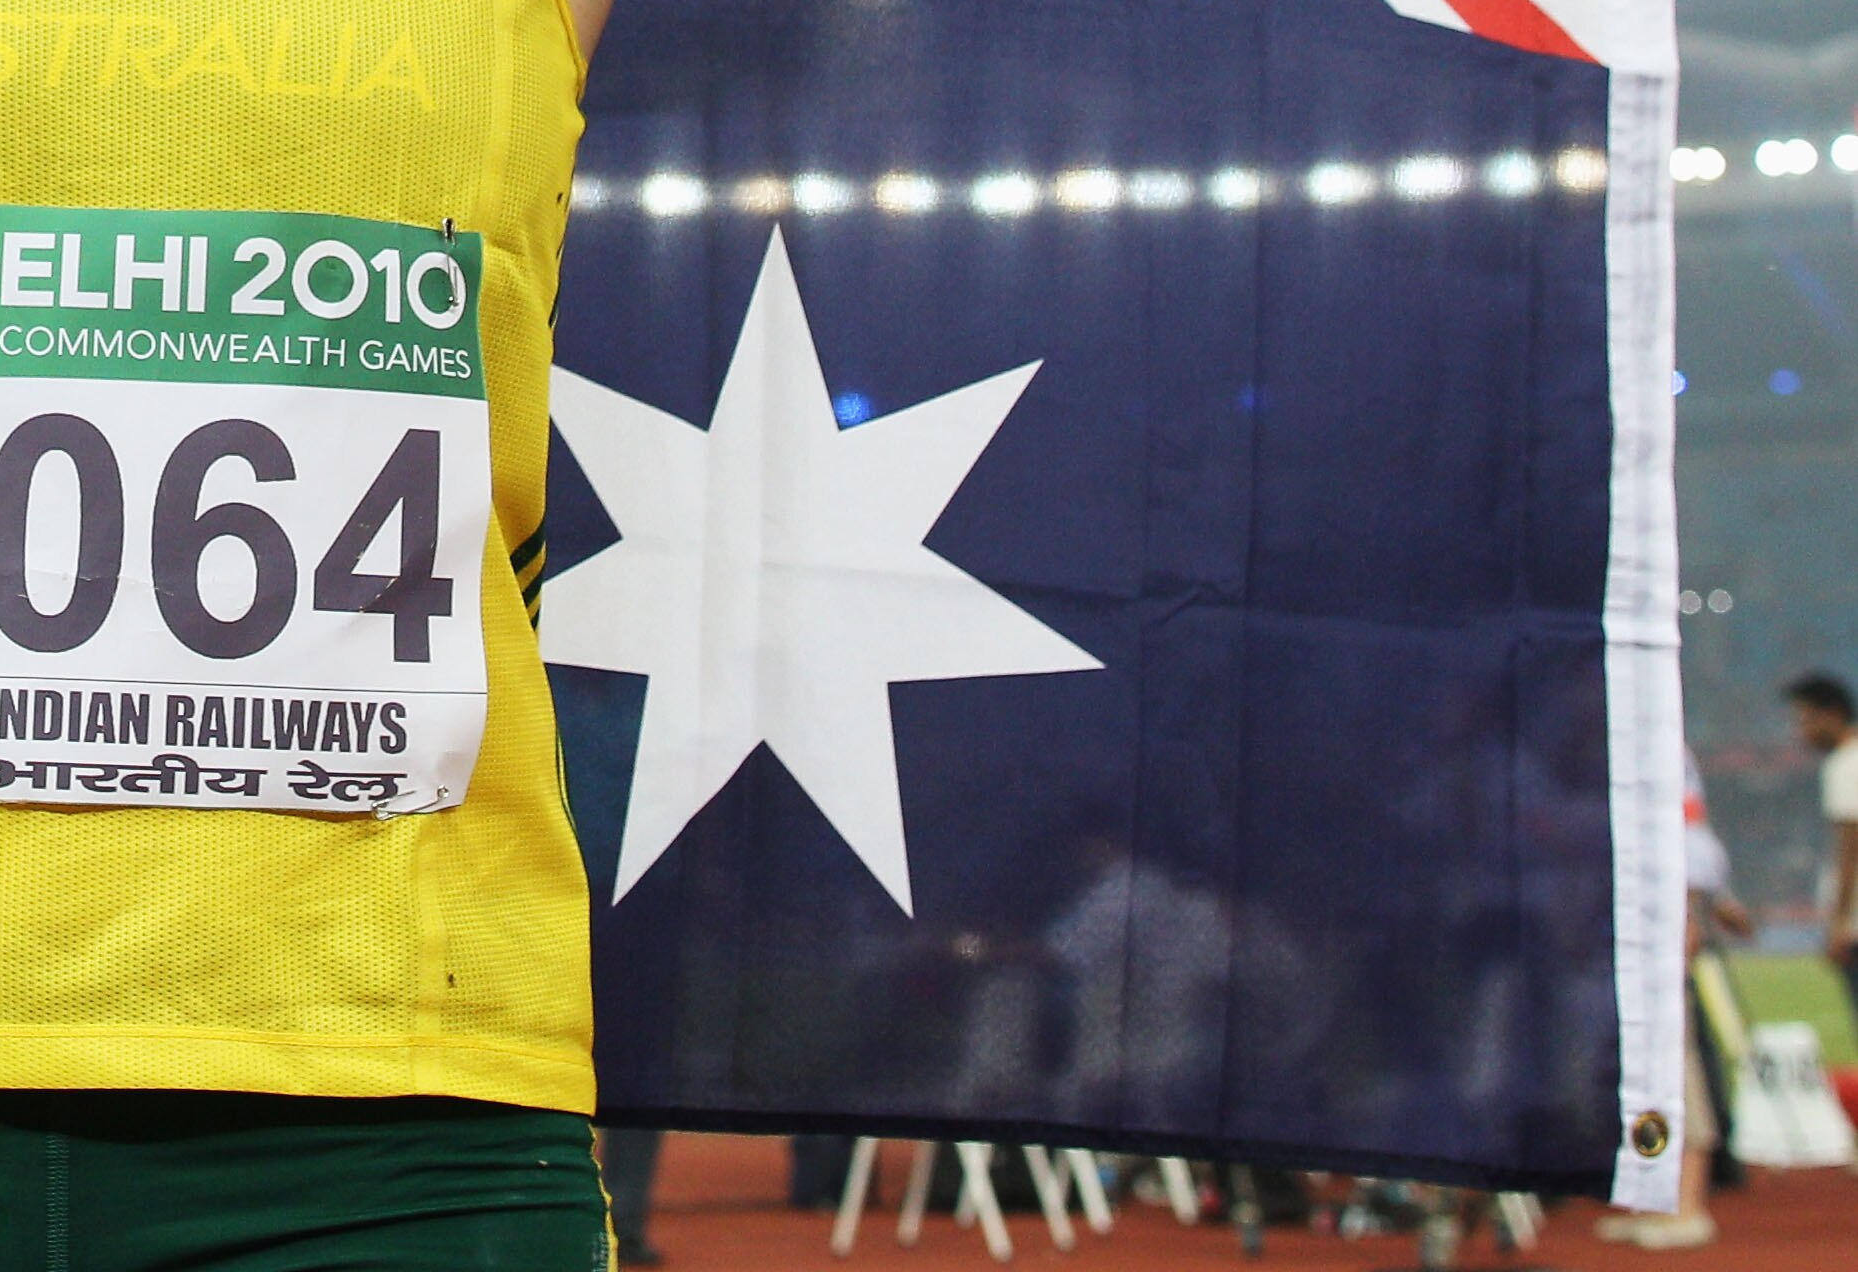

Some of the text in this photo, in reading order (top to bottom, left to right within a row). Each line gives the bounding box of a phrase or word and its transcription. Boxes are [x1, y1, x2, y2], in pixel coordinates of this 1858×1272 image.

[231, 237, 467, 329] 2010
[359, 340, 472, 379] GAMES
[167, 694, 407, 755] RAILWAYS
[286, 759, 407, 804] रेल
